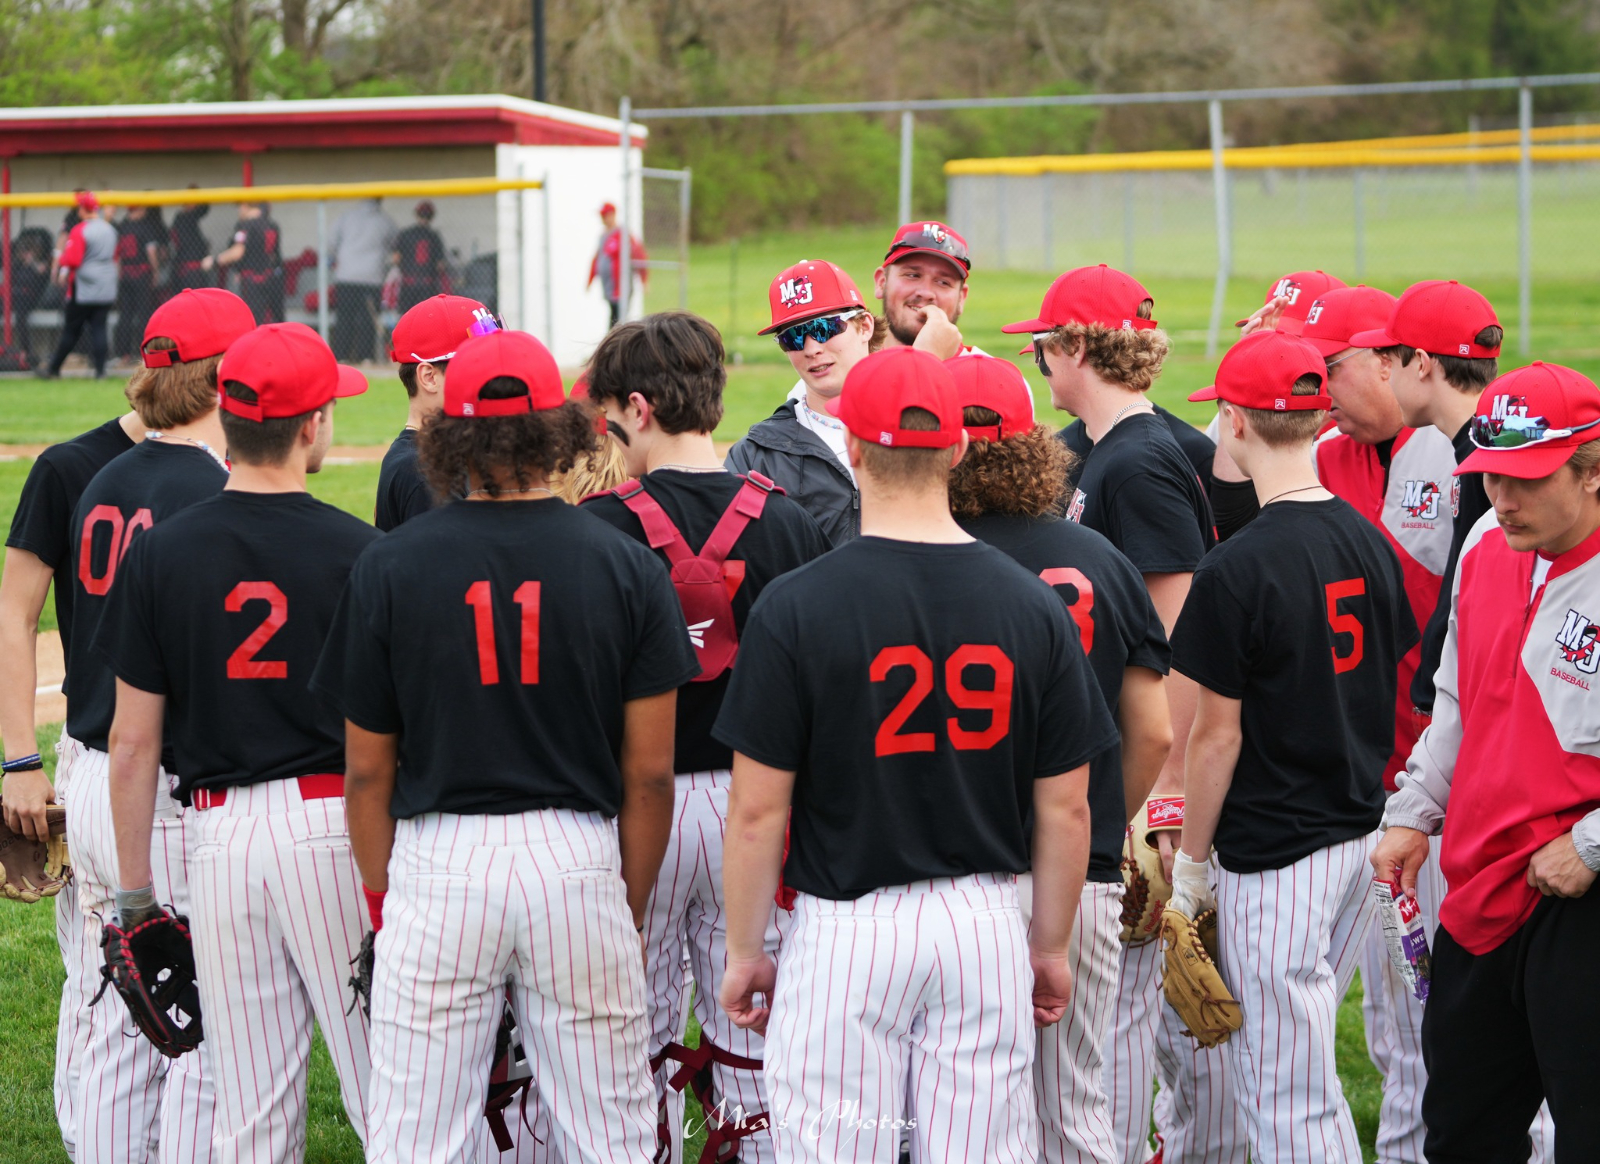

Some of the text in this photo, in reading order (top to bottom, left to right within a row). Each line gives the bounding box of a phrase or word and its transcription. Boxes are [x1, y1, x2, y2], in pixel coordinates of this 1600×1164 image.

[1401, 521, 1436, 530] BASEBALL
[224, 581, 288, 679] 2
[464, 580, 541, 685] 11
[1325, 577, 1365, 675] 5
[869, 643, 1014, 757] 29
[1550, 667, 1590, 691] BASEBALL
